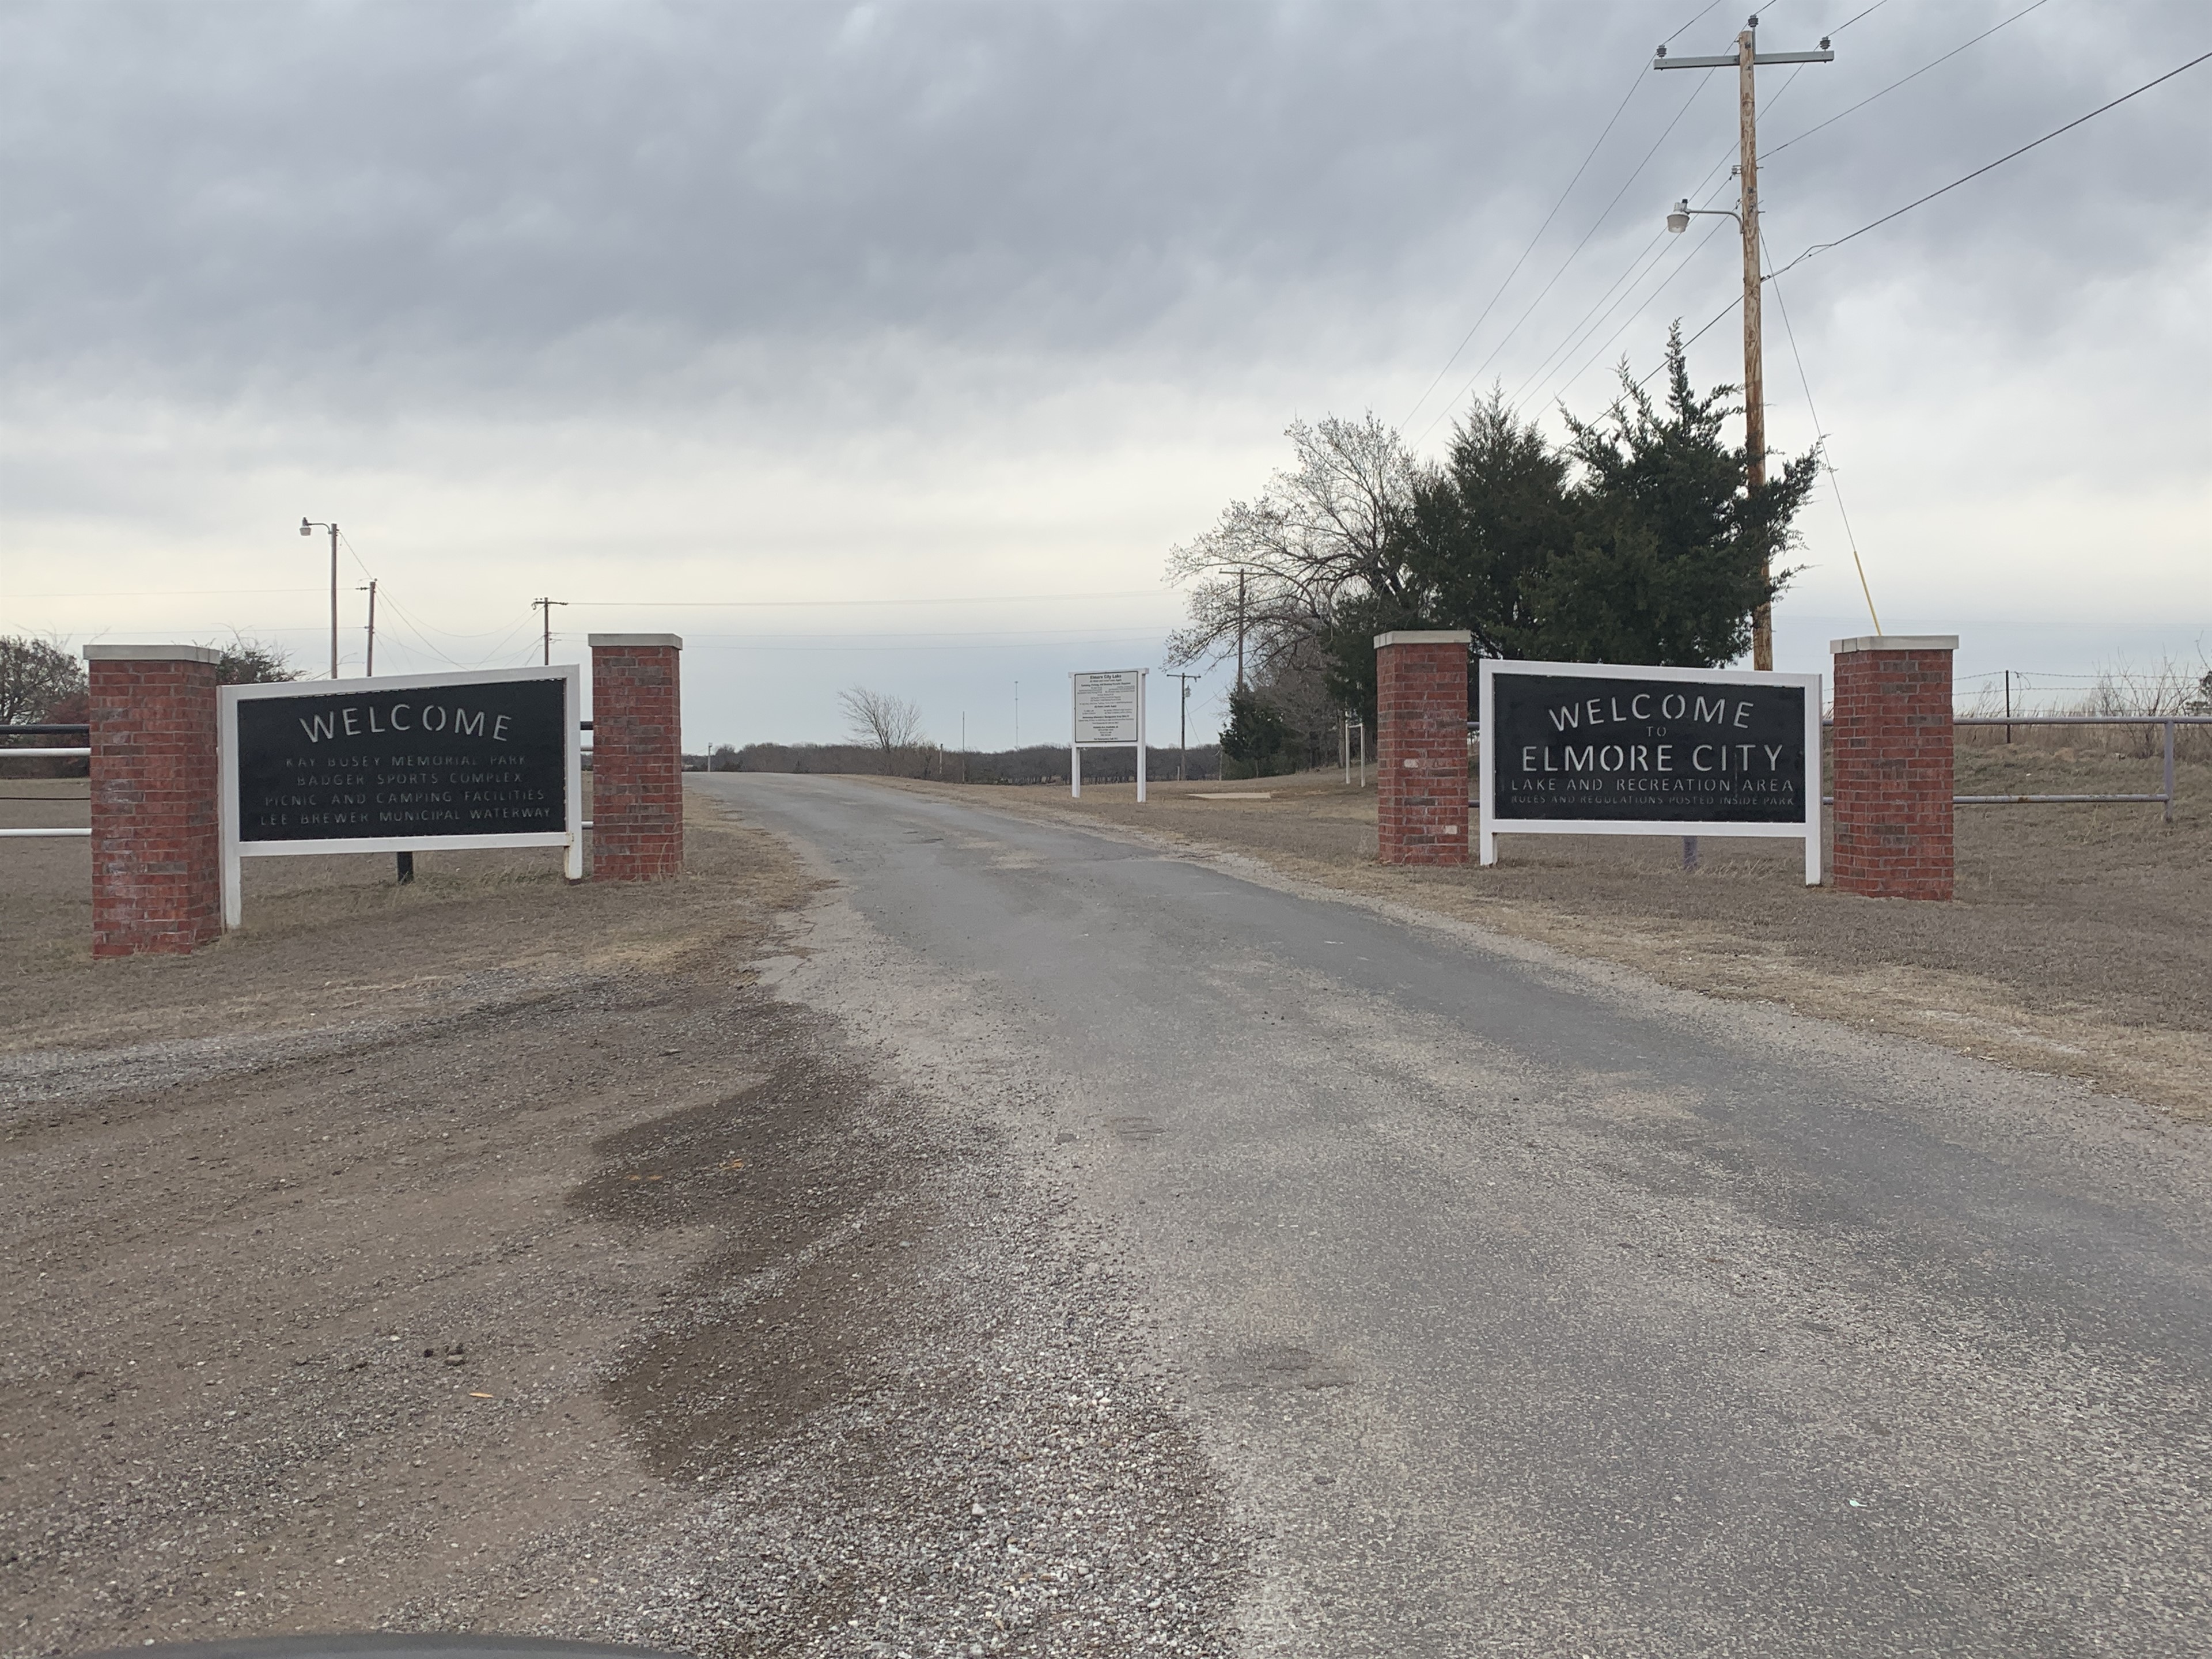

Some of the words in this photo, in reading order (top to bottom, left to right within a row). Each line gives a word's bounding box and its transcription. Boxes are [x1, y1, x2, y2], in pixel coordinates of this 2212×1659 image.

[1548, 693, 1755, 732] WELCOME
[300, 703, 512, 743] WELCOME
[1646, 726, 1667, 737] TO
[328, 755, 380, 767] BUSEY
[392, 755, 478, 767] MEMORIAL
[490, 755, 527, 766] PARK
[1522, 744, 1673, 772] ELMORE
[1692, 744, 1783, 772] CITY
[297, 774, 365, 786] BADGER
[377, 772, 438, 785] SPORTS
[449, 771, 523, 783] COMPLEX
[1512, 778, 1556, 791] LAKE
[1566, 778, 1603, 791] AND
[1616, 778, 1730, 791] RECREATION
[1742, 779, 1794, 792] AREA
[264, 794, 317, 806] PICNIC
[331, 793, 366, 805] AND
[376, 791, 452, 804] CAMPING
[464, 789, 544, 802] FACILITIES
[1511, 795, 1546, 804] RULES
[1551, 795, 1575, 804] AND
[1580, 796, 1664, 805] REGULATIONS
[1669, 797, 1714, 805] POSTED
[1719, 797, 1758, 805] INSIDE
[1763, 797, 1794, 806] PARK
[260, 813, 288, 826] LEE
[300, 812, 369, 824] BREWER
[380, 809, 460, 823] MUNICIPAL
[469, 807, 551, 820] WATERWAY
